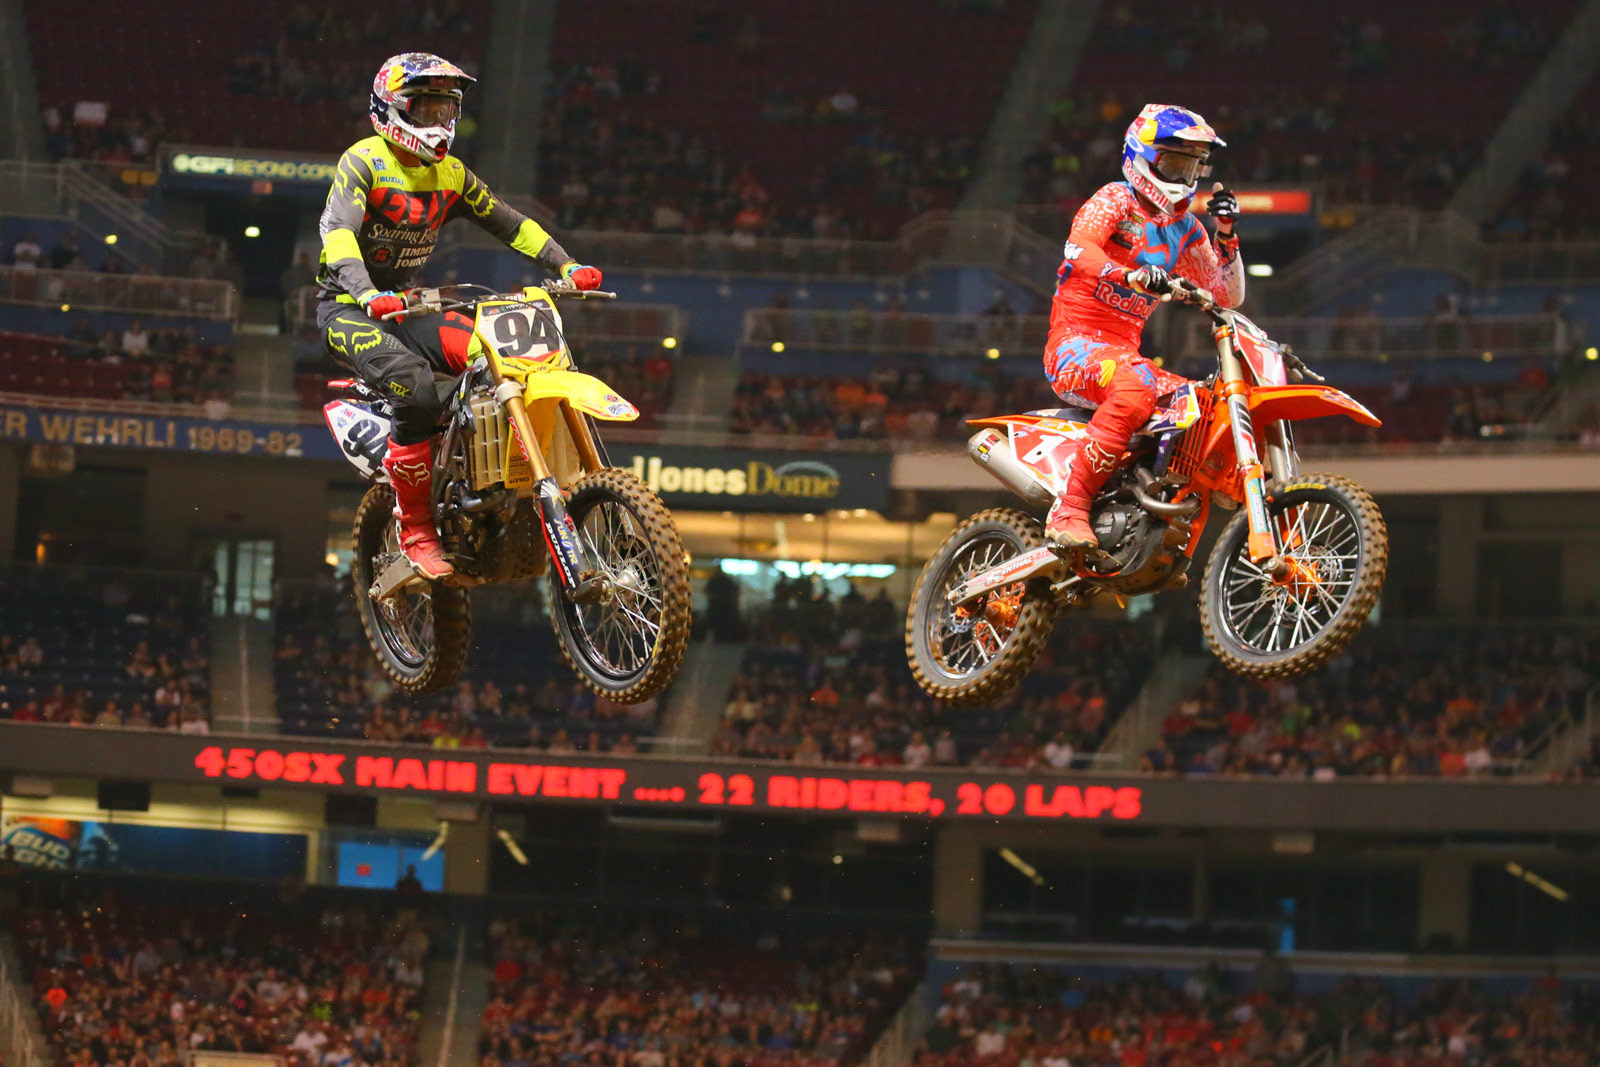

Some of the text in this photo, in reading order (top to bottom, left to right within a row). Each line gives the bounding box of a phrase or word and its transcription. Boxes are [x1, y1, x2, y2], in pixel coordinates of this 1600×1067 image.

[391, 126, 420, 153] Bull
[1123, 155, 1170, 209] Red Bull
[367, 223, 421, 245] Soaring
[399, 244, 436, 259] JIMMY
[1096, 280, 1138, 313] Red
[494, 308, 561, 359] 94
[389, 381, 410, 397] FOX
[39, 413, 176, 449] WEHRLI
[187, 426, 303, 457] 1969-82
[342, 419, 388, 470] 94
[545, 521, 577, 589] DUNLOP
[195, 746, 345, 785] 450SX
[355, 756, 477, 793] MAIN
[487, 763, 626, 799] EVENT
[699, 773, 754, 806] 22
[767, 776, 945, 817] RIDERS,
[957, 782, 1015, 815] 20
[1025, 784, 1142, 819] LAPS
